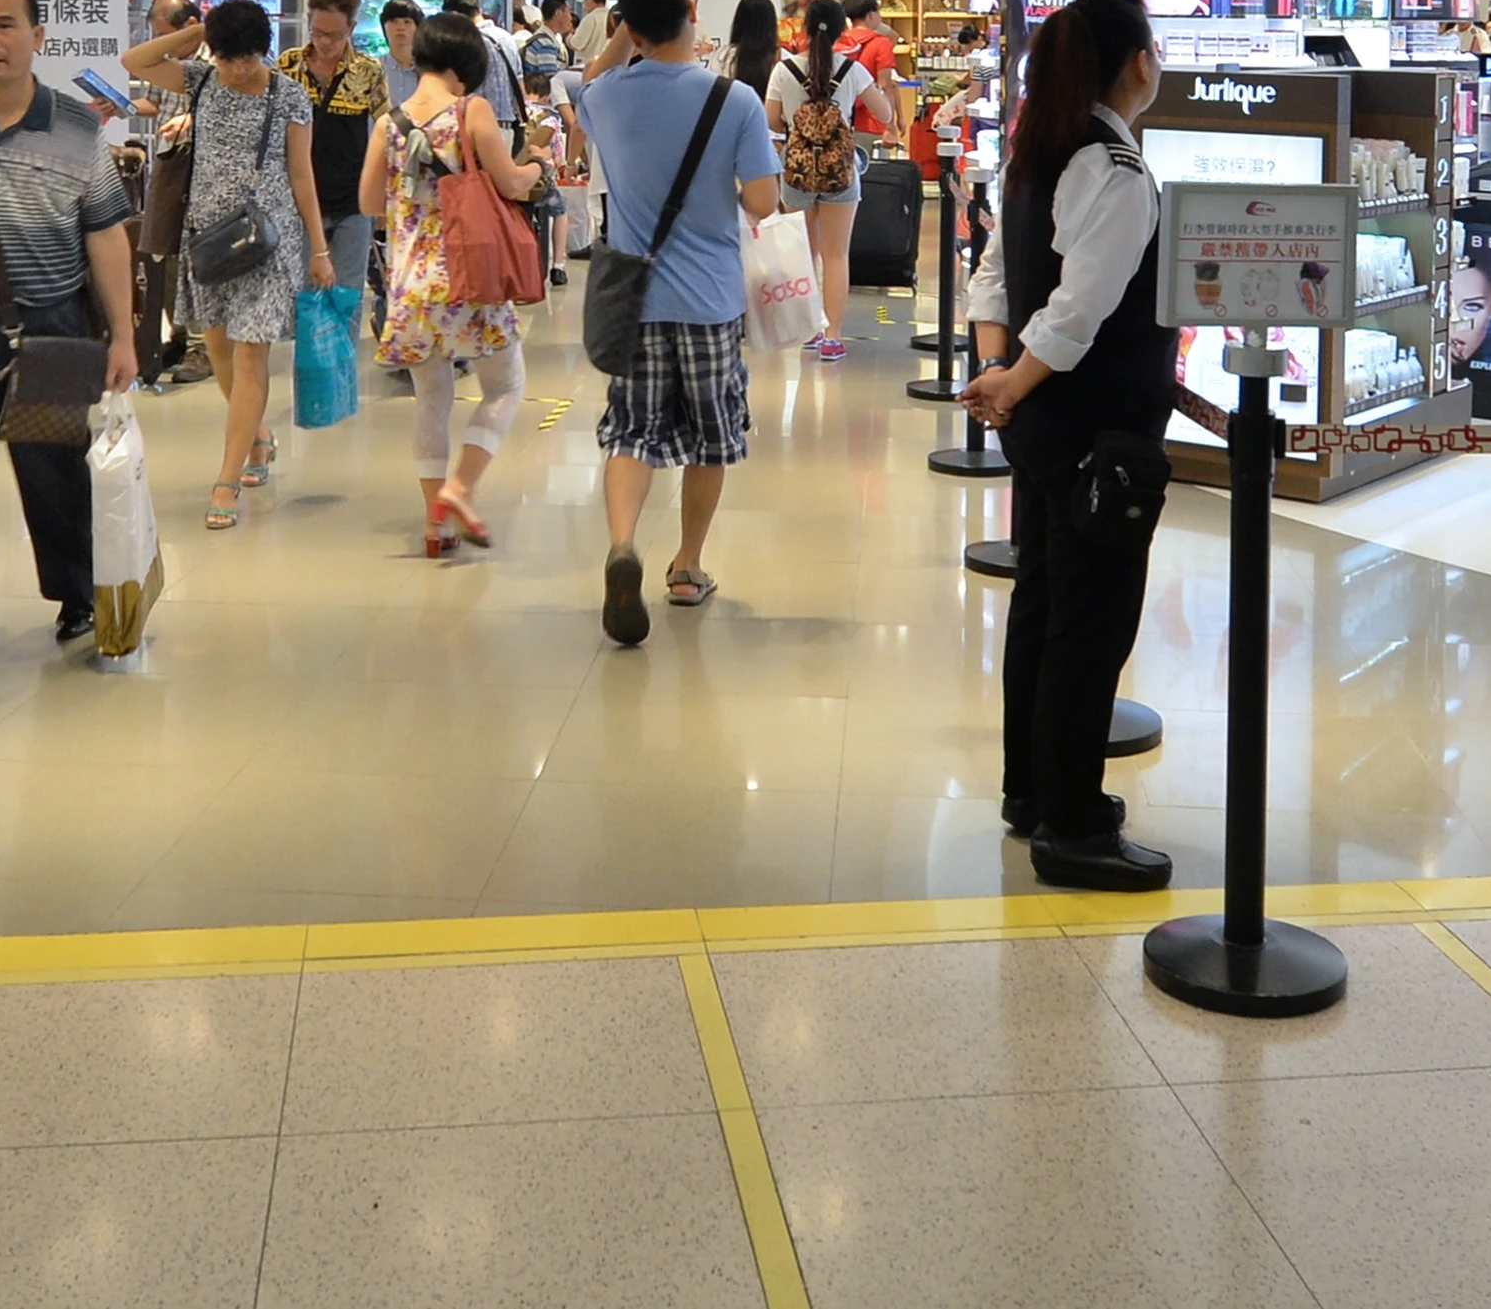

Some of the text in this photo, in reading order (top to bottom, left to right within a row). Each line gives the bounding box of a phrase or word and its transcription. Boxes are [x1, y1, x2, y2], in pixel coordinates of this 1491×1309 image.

[35, 37, 119, 58] 店內選購
[1187, 76, 1277, 115] Jurlique
